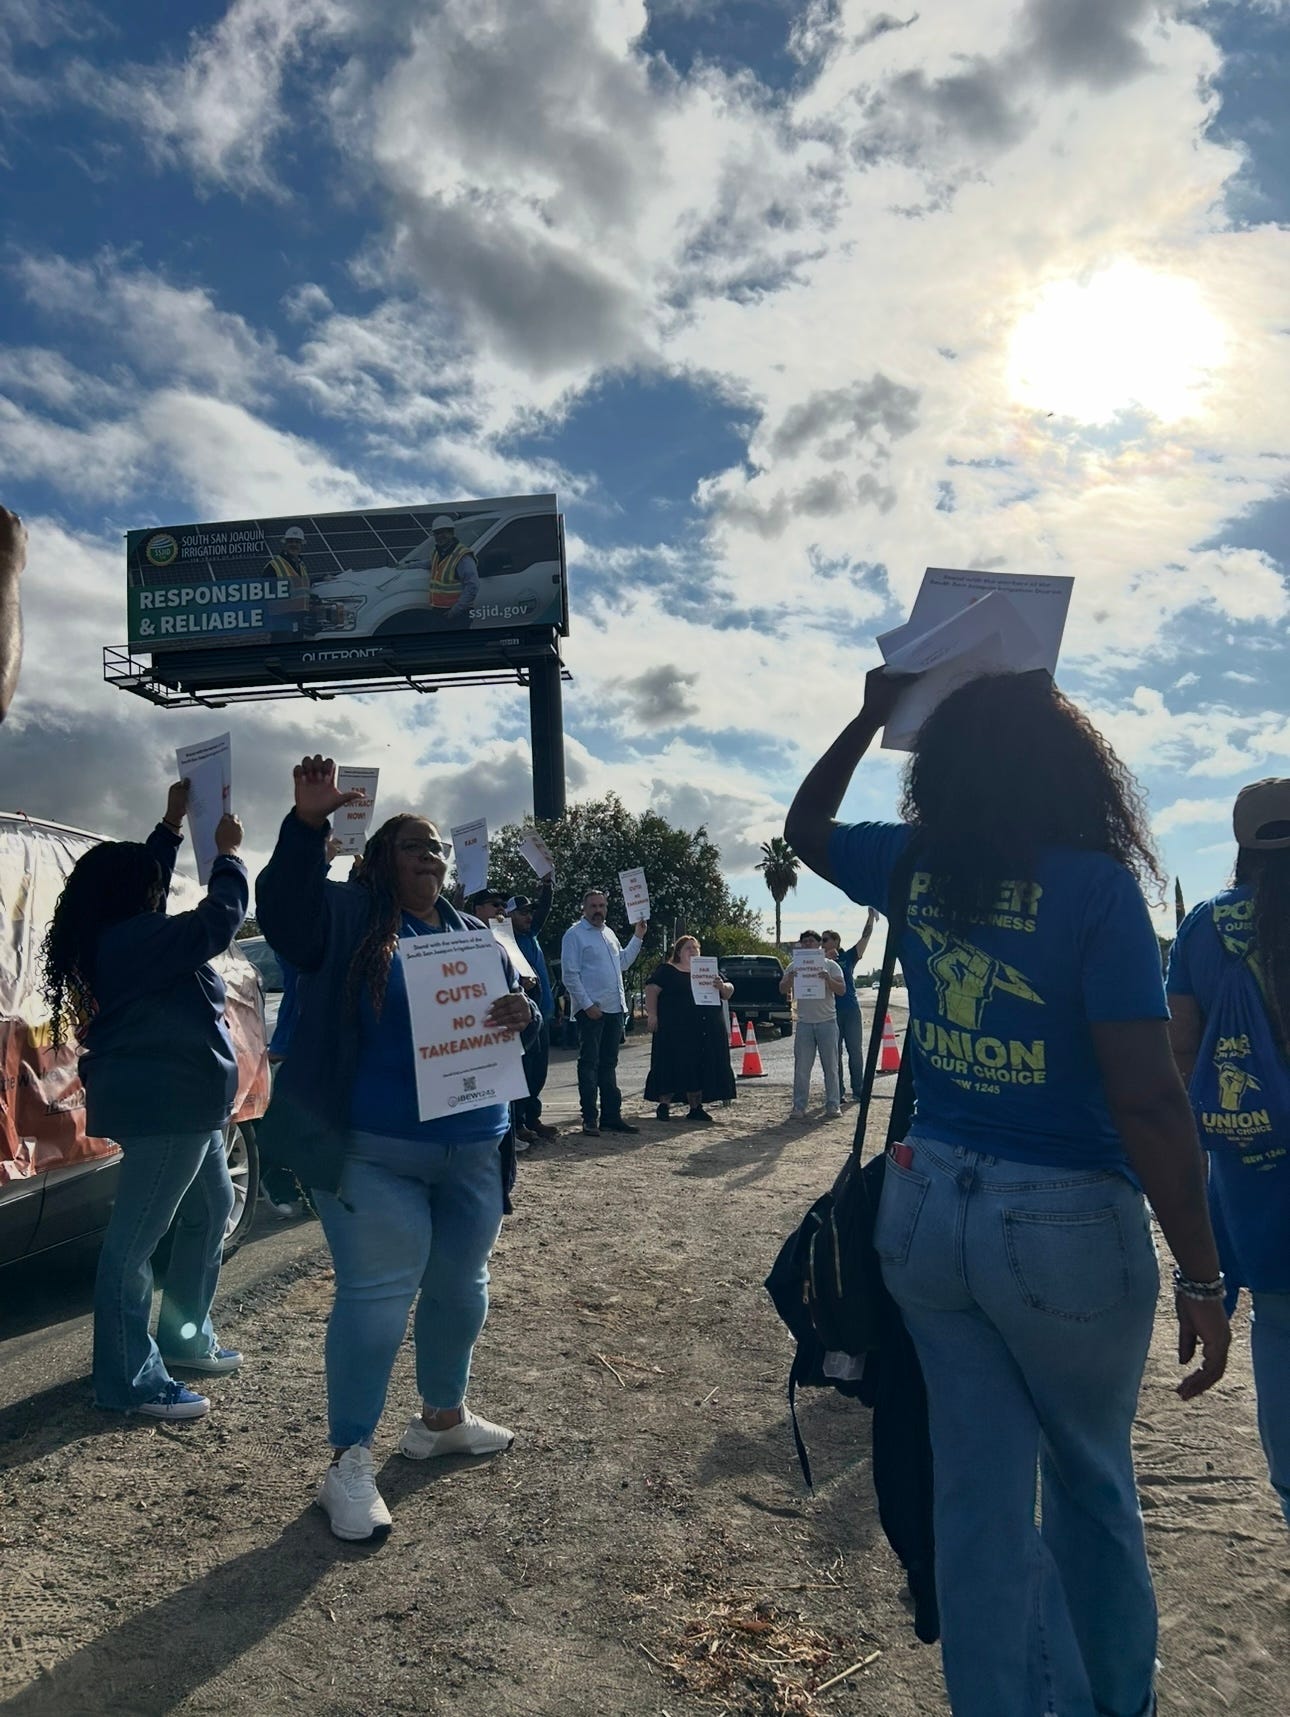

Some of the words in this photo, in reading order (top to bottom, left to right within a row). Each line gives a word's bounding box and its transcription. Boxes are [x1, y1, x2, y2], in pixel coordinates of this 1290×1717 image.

[182, 534, 209, 547] SOUTH
[210, 532, 228, 545] SAN
[229, 529, 265, 543] JOAQUIN
[181, 544, 227, 558] IRRIGATION
[229, 540, 265, 554] DISTRICT
[139, 580, 289, 609] RESPONSIBLE
[139, 618, 155, 636] &
[160, 609, 263, 634] RELIABLE
[469, 605, 528, 620] ssjid.gov
[909, 871, 1043, 916] PER
[442, 960, 468, 978] NO
[435, 982, 488, 1005] CUTS!
[453, 1015, 476, 1030] NO
[419, 1029, 515, 1060] TAKEAWAYS!
[912, 1018, 1046, 1070] UNION
[930, 1055, 968, 1074] OUR
[973, 1065, 1046, 1085] CHOICE
[974, 1083, 1001, 1095] 1245
[1202, 1108, 1270, 1129] UNION
[1236, 1124, 1273, 1136] CHOICE
